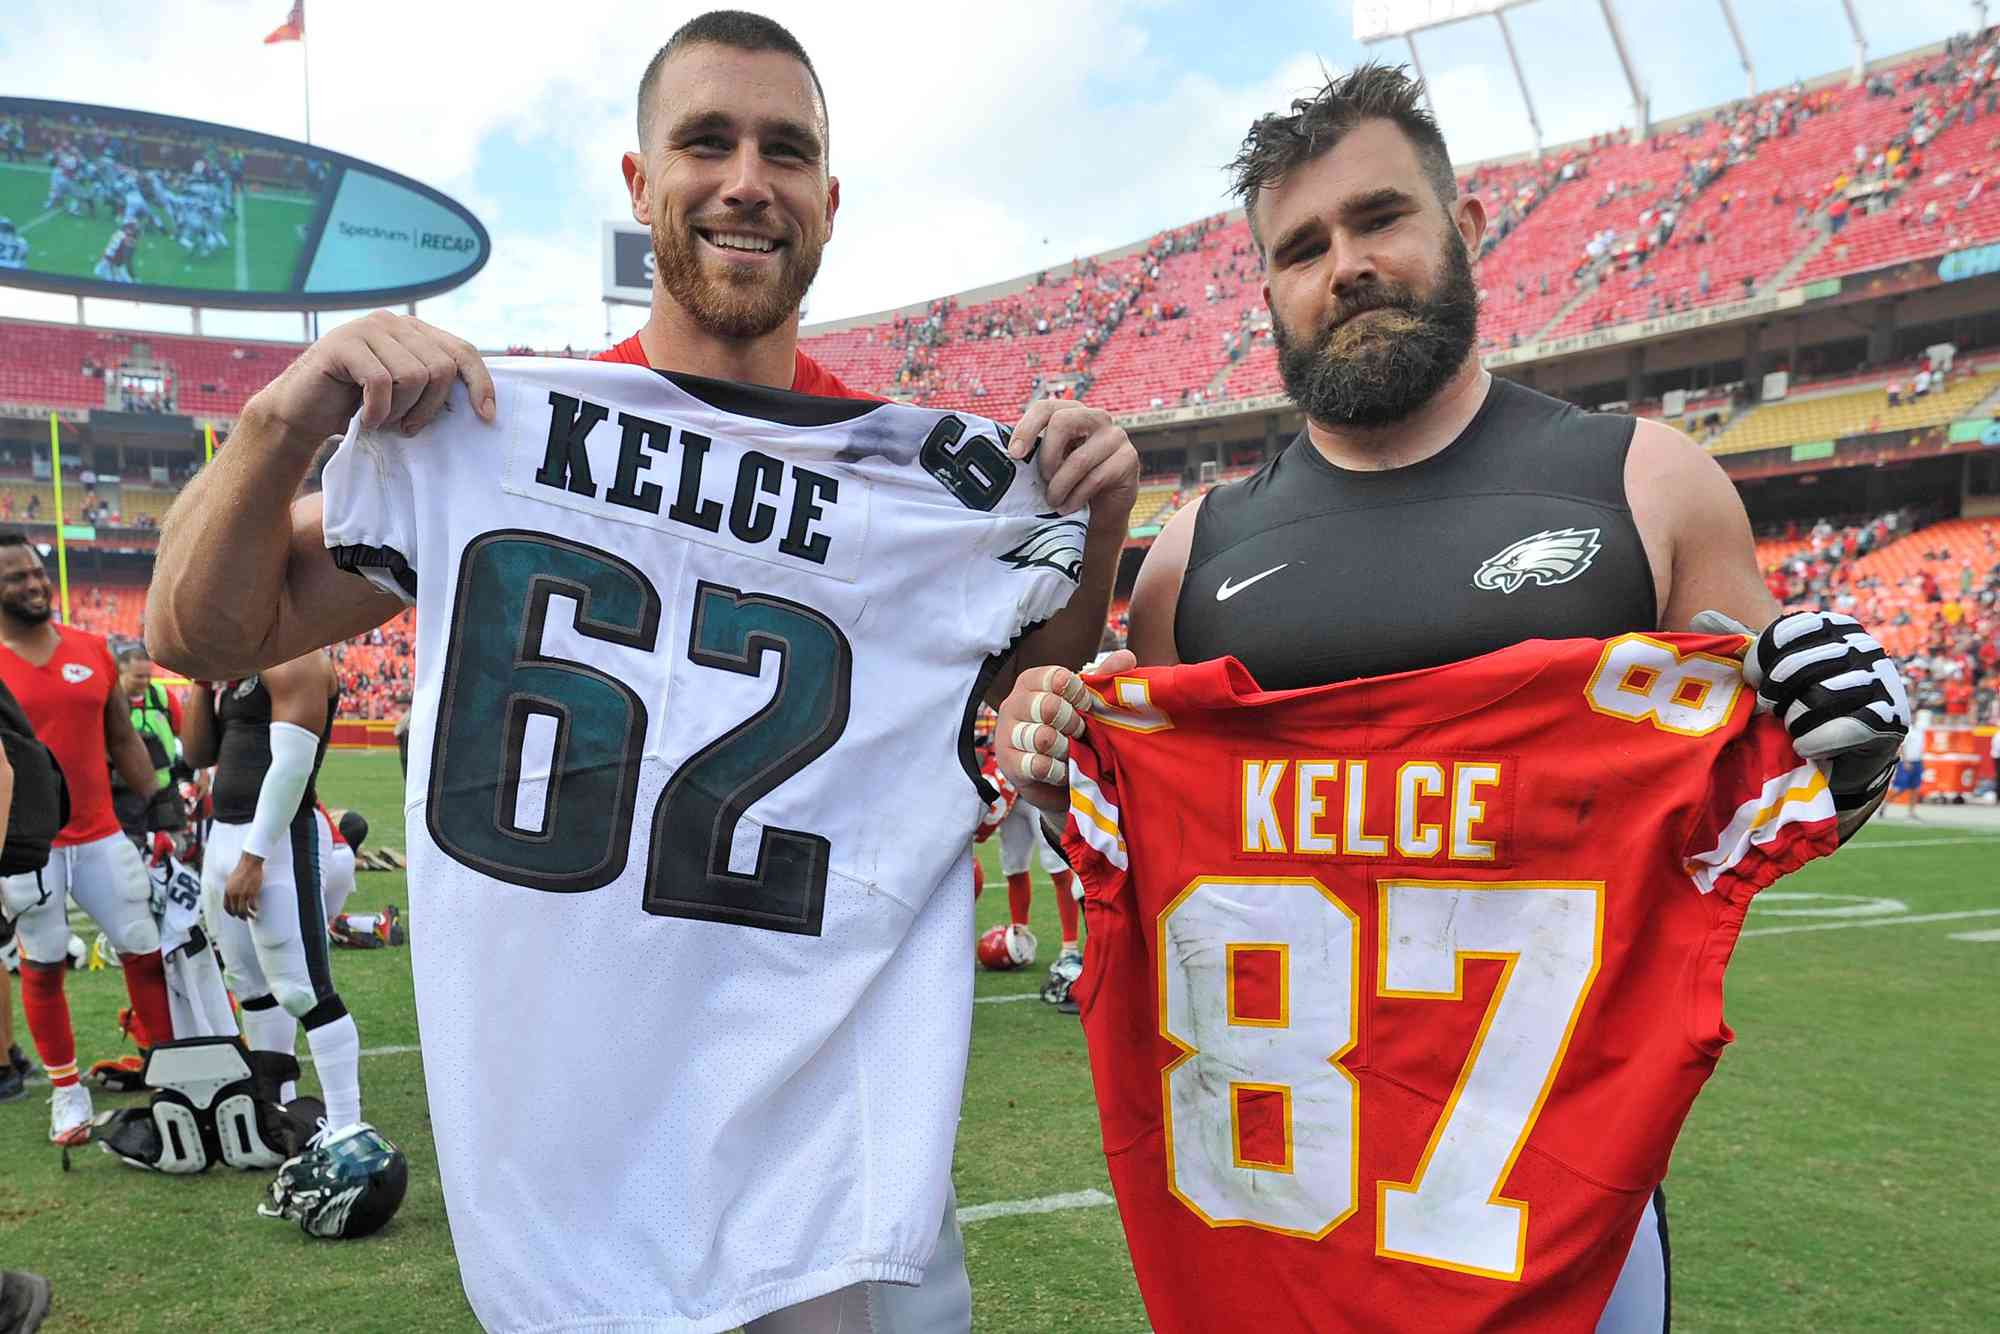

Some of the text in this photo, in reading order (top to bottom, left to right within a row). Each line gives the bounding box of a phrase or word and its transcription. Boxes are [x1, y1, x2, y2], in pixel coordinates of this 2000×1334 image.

[339, 221, 475, 252] Spectrum RECAP
[535, 391, 839, 565] KELCE
[919, 414, 1042, 513] 6
[426, 528, 853, 936] 62
[1583, 632, 1752, 737] 8
[1242, 759, 1502, 861] KELCE
[169, 872, 202, 911] 58
[1157, 875, 1606, 1281] 87
